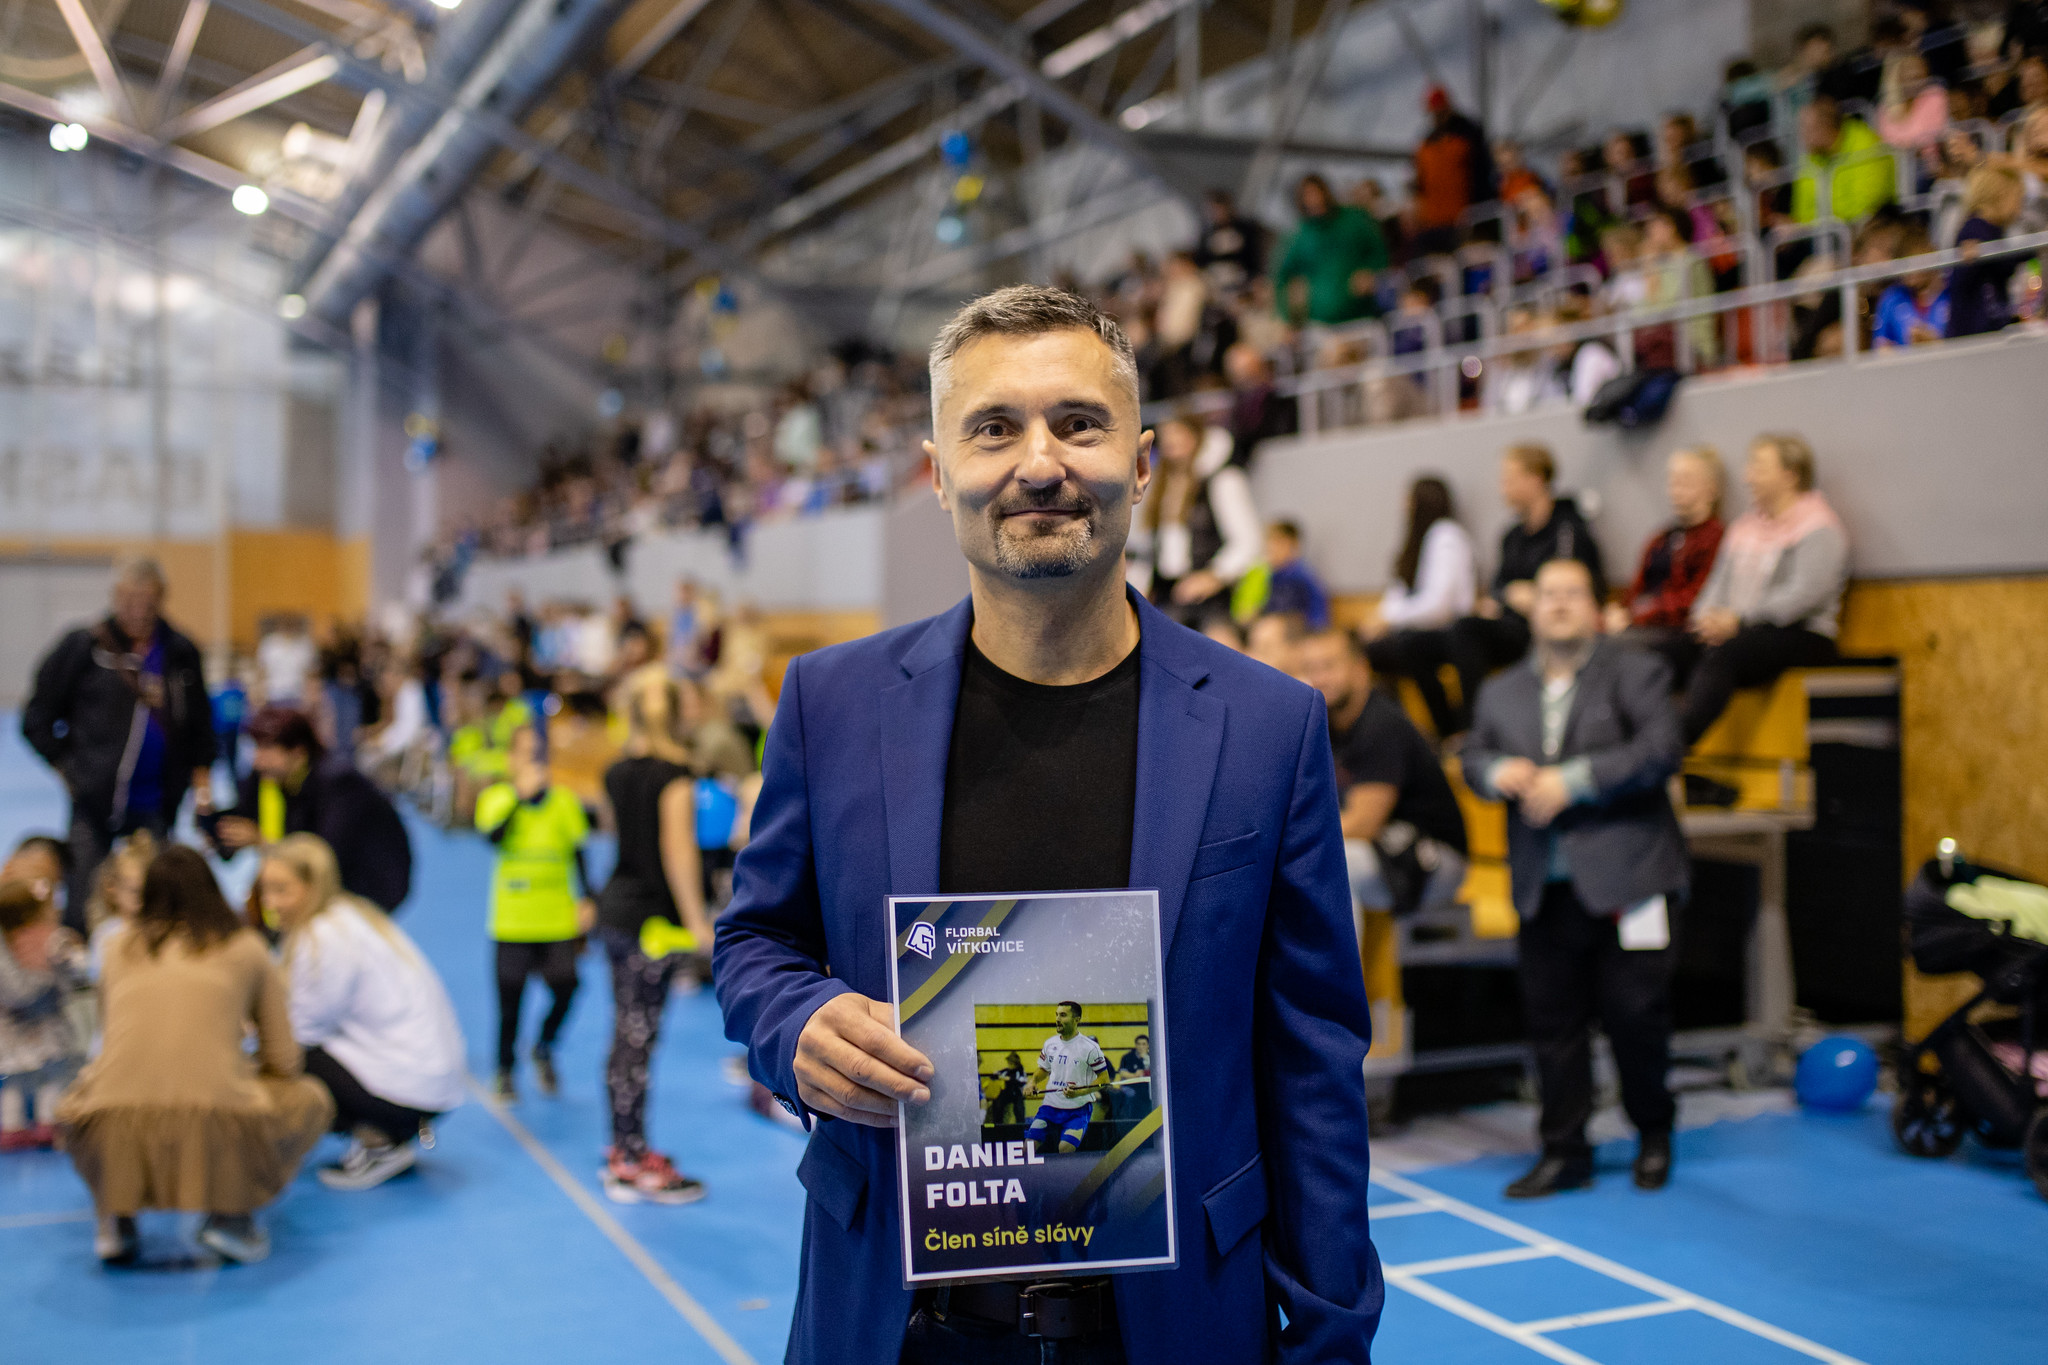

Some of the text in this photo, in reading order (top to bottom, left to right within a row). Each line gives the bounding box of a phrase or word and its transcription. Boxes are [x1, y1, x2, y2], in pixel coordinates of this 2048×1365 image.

[945, 926, 1001, 938] FLORBAL
[946, 938, 1025, 954] VÍTKOVICE
[924, 1140, 1045, 1171] DANIEL
[926, 1178, 1027, 1209] FOLTA
[924, 1222, 1095, 1251] Člen síně slávy
